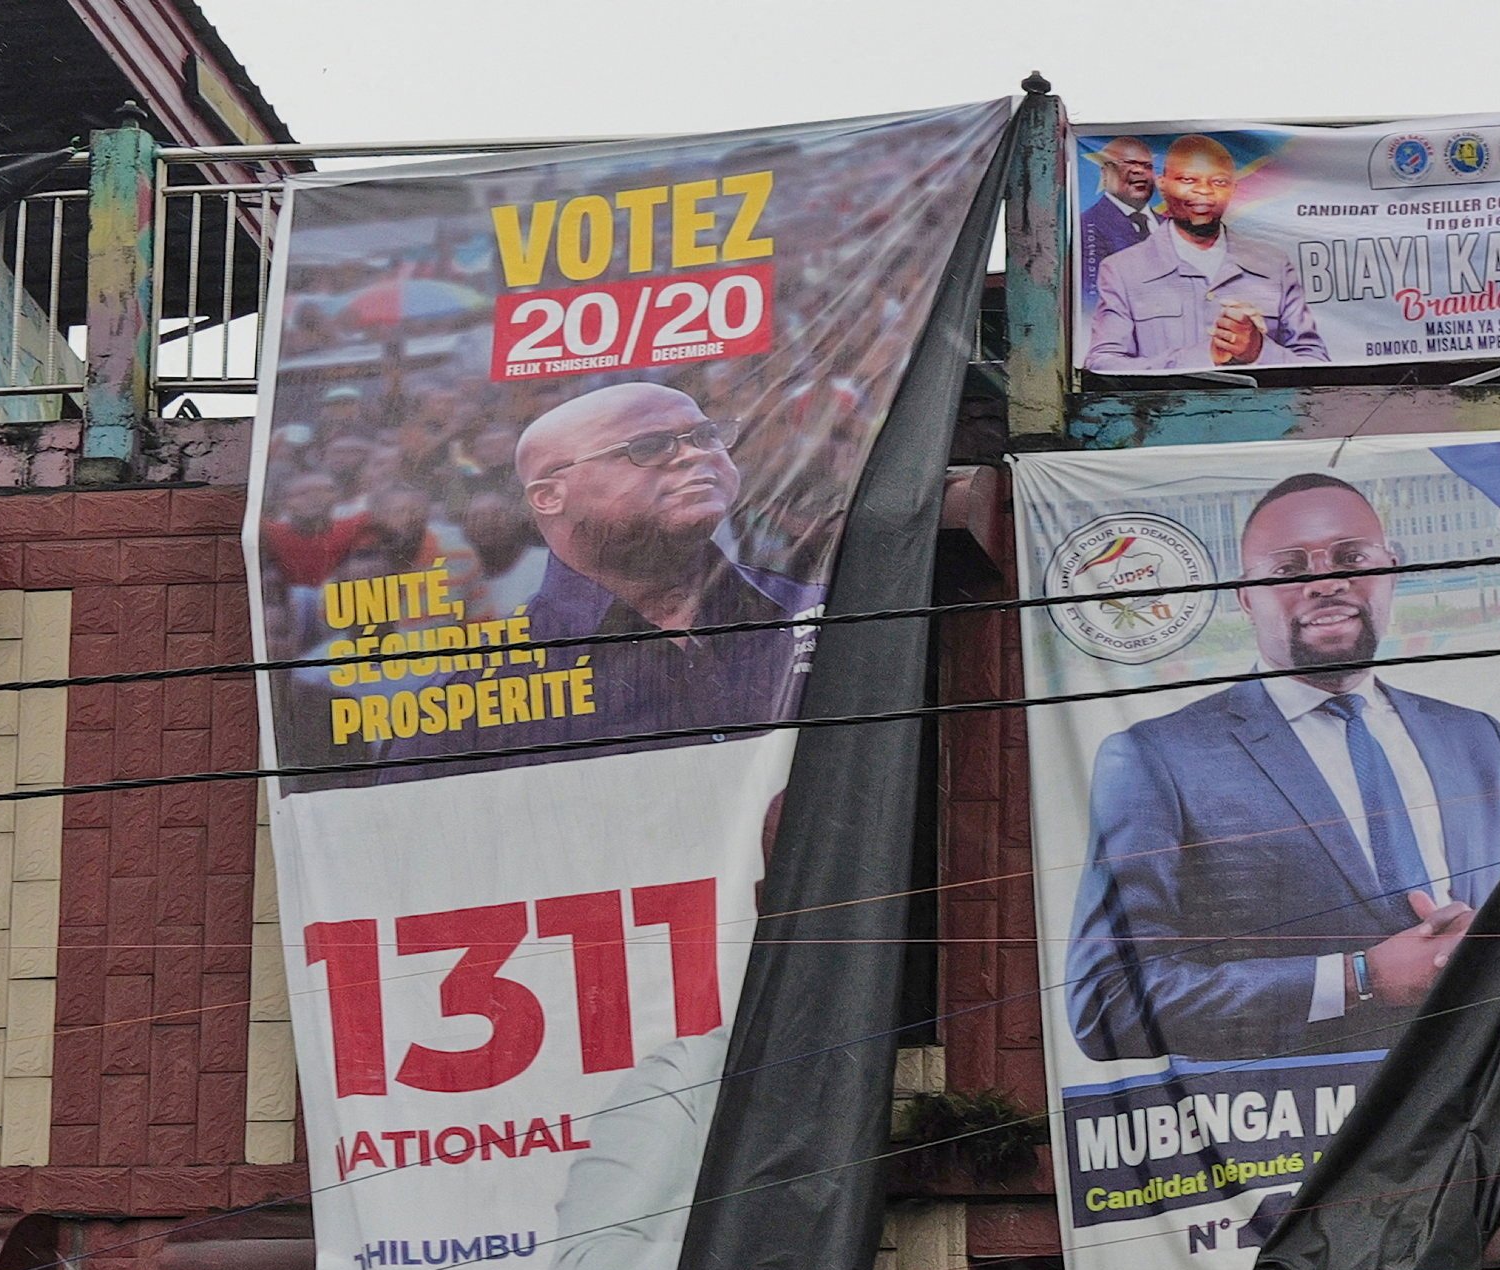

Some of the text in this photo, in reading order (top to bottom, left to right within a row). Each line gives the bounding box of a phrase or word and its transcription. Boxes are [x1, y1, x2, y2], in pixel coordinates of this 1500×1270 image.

[492, 170, 775, 287] VOTEZ
[1297, 204, 1378, 216] CANDIDAT
[1388, 199, 1481, 216] CONSEILLER
[1299, 235, 1430, 303] BIAYI
[508, 274, 765, 366] 20/20
[1425, 320, 1474, 336] MASINA
[1478, 319, 1495, 333] YA
[1426, 337, 1472, 352] MISALA
[505, 353, 620, 376] FELIX TSHISEKEDI
[651, 342, 724, 362] DECEMBRE
[1061, 526, 1199, 589] UNION POUR LA DEMOCRATIE
[1114, 565, 1154, 585] UDPS
[328, 608, 547, 688] SÉCURITÉ,
[1095, 602, 1196, 649] PROGRES SOCIAL
[332, 658, 595, 745] PROSPÉRITÉ
[304, 878, 721, 1099] 1311
[1077, 1089, 1303, 1172] MUBENGA
[1086, 1156, 1303, 1211] Candidat Député
